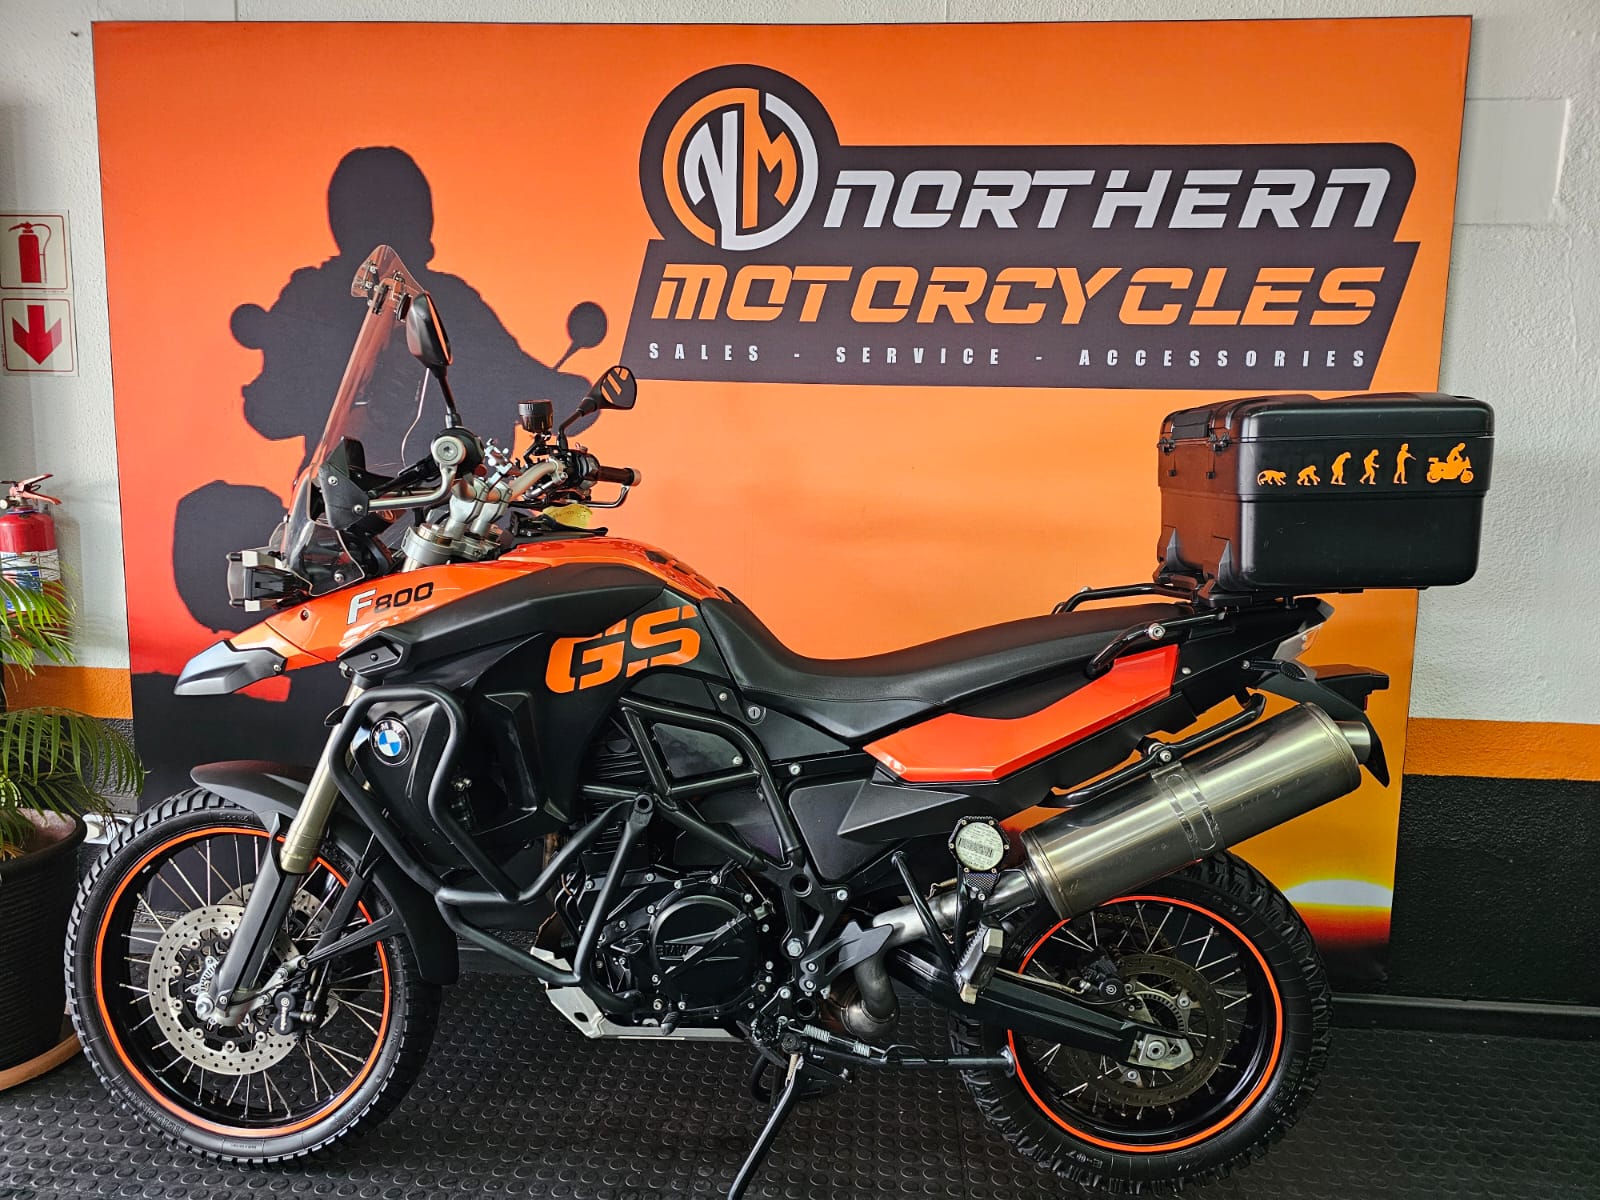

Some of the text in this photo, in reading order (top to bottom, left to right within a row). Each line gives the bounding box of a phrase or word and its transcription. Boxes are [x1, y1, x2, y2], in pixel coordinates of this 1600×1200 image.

[823, 168, 1391, 229] NORTHERN
[651, 262, 1385, 326] MOTORCYCLES
[648, 342, 759, 362] SALES
[835, 346, 999, 365] SERVICE
[1078, 349, 1365, 368] ACCESSORIES
[545, 605, 701, 694] GS
